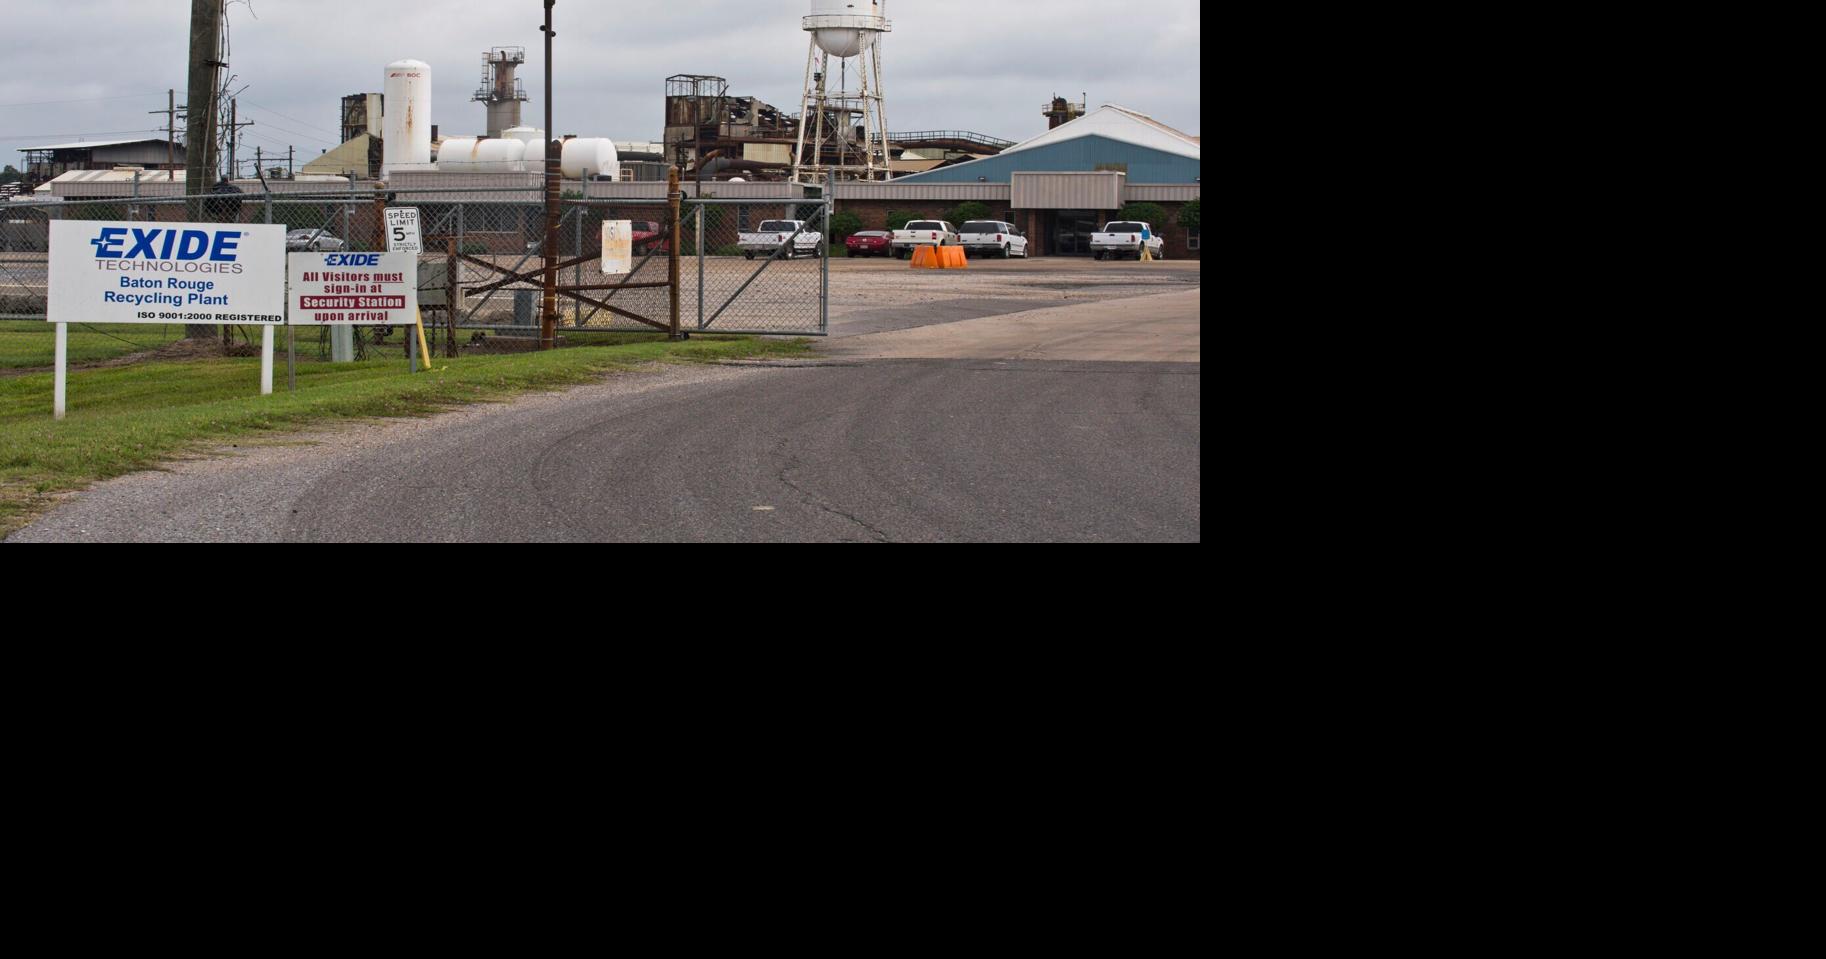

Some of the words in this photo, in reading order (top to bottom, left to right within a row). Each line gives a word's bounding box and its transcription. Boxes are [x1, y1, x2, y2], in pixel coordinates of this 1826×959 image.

[393, 227, 406, 241] 5
[90, 227, 242, 262] EXIDE
[324, 254, 380, 266] EXIDE
[95, 260, 243, 274] TECHNOLOGIES
[302, 272, 318, 282] All
[322, 272, 370, 282] Visitors
[373, 272, 404, 282] must
[120, 276, 162, 288] Baton
[167, 278, 214, 292] Rouge
[324, 284, 368, 294] sign-in
[370, 284, 382, 293] at
[104, 291, 182, 306] Recycling
[188, 293, 228, 305] Plant
[304, 296, 356, 309] Security
[358, 296, 402, 307] Station
[158, 312, 212, 320] 9001:2000
[214, 314, 282, 322] REGISTERED
[314, 311, 344, 322] upon
[348, 311, 388, 321] arrival
